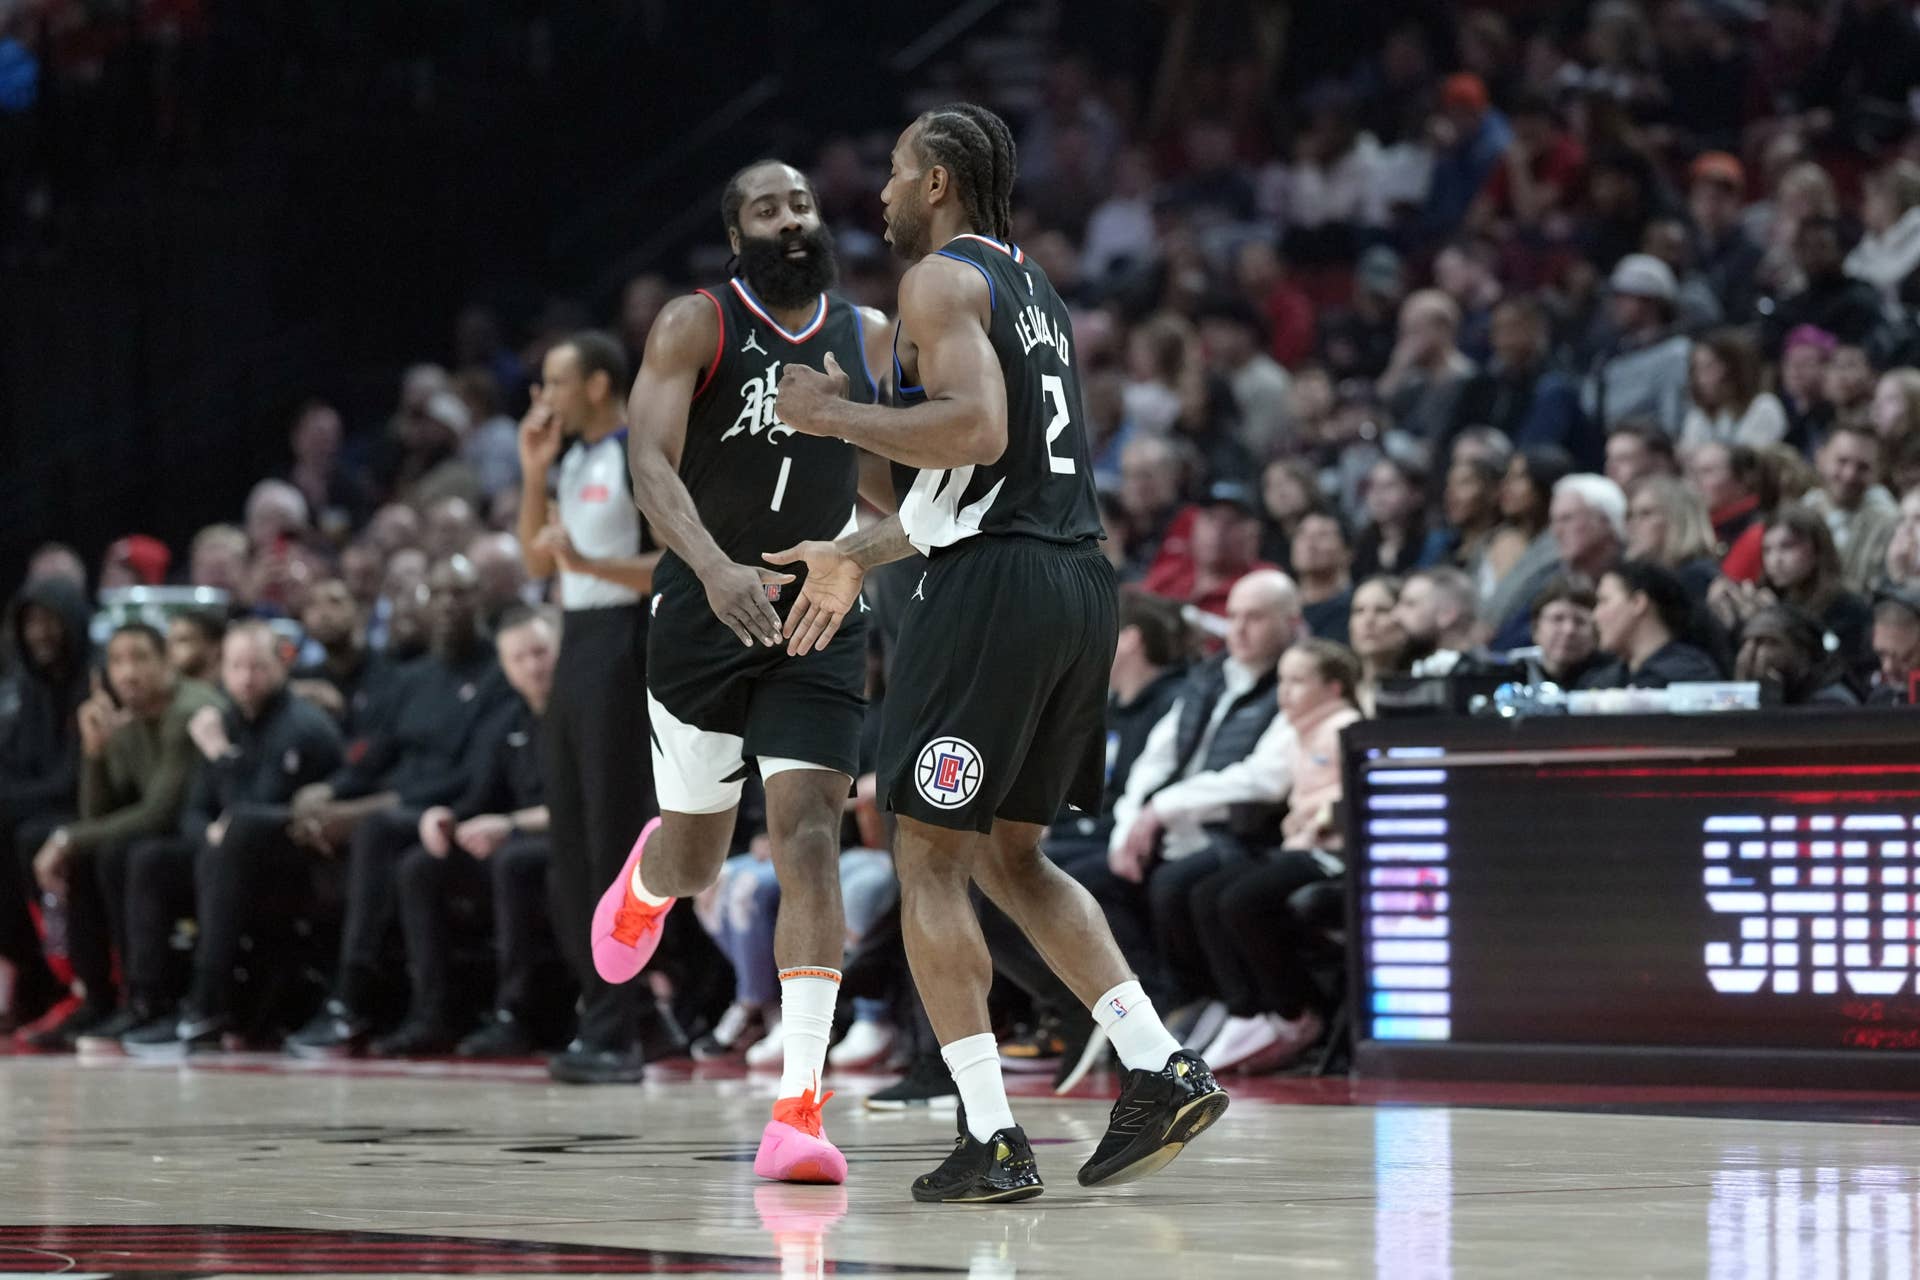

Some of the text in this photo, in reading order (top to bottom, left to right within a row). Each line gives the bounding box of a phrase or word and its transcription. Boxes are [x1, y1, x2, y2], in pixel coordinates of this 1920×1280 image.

[1041, 373, 1076, 474] 2
[770, 456, 792, 512] 1
[1703, 815, 1920, 994] SHO
